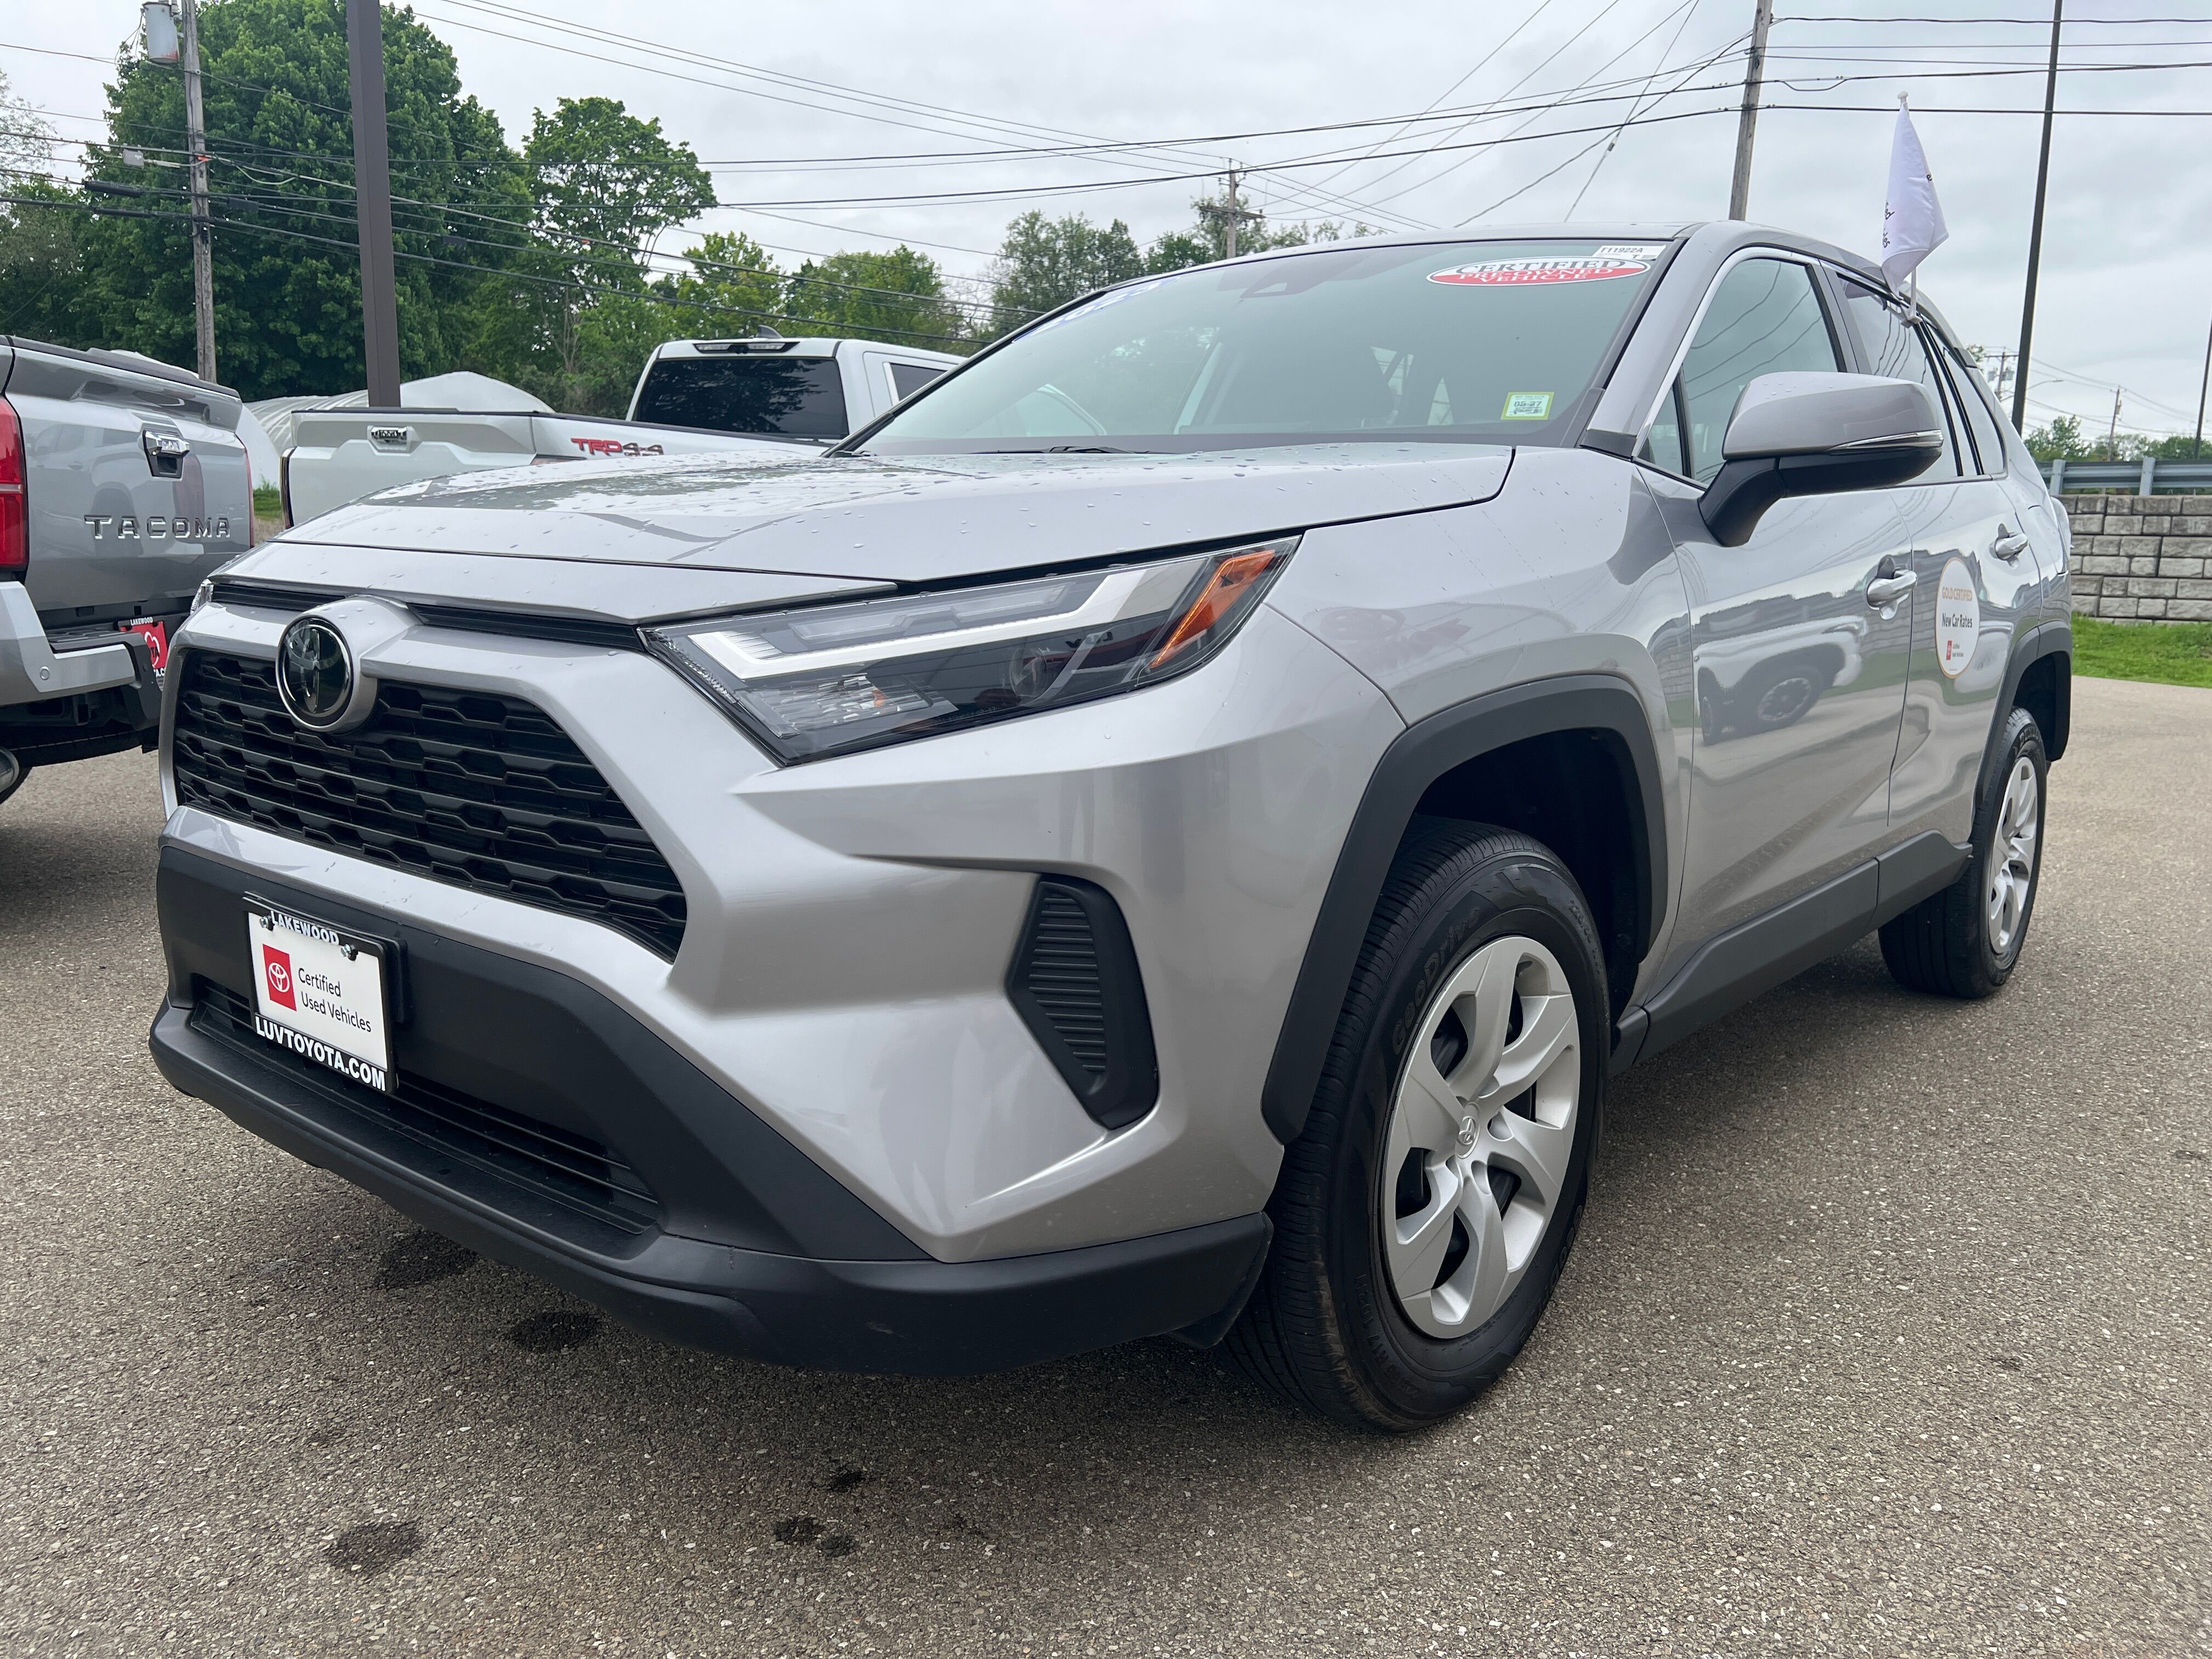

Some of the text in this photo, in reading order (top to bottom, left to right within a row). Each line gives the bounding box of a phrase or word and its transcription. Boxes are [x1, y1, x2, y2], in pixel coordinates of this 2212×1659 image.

[1456, 261, 1626, 274] CERTIFIED
[1458, 269, 1613, 279] PRE-OWNED
[1480, 274, 1587, 283] VEHICLE
[571, 438, 623, 456] TRD
[84, 515, 230, 539] TACOMA
[1942, 586, 1972, 601] GOLD CERTIFIED
[130, 617, 153, 625] LAKEWOOD
[1942, 613, 1951, 627] New
[1960, 614, 1972, 628] Rates
[270, 911, 340, 946] LAKEWOOD
[298, 968, 341, 997] Certified
[301, 991, 371, 1032] Used Vehicles
[256, 1016, 386, 1091] LUVTOYOTA.COM
